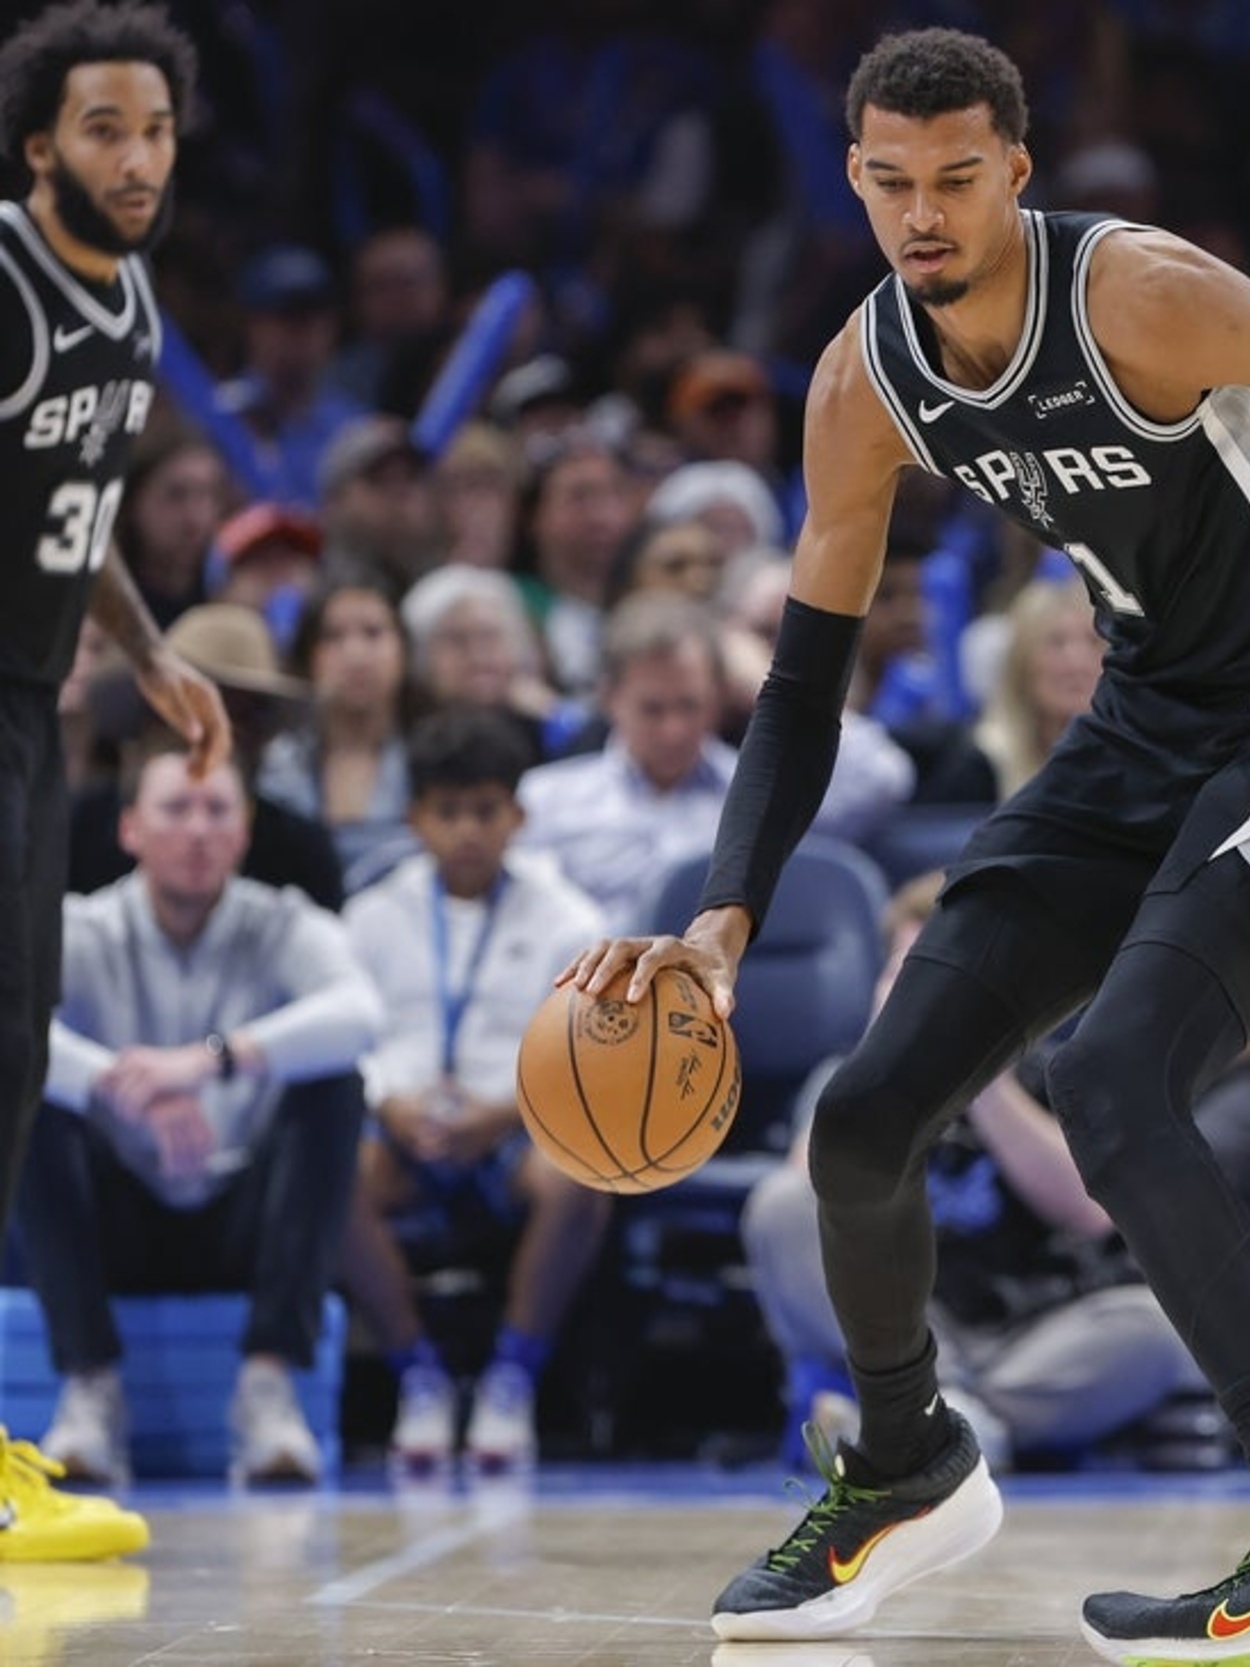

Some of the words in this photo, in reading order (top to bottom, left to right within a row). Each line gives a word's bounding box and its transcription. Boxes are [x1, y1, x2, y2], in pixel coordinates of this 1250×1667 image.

[23, 379, 153, 464] SPUR
[1037, 390, 1083, 411] LEDGER
[1064, 543, 1146, 616] 1
